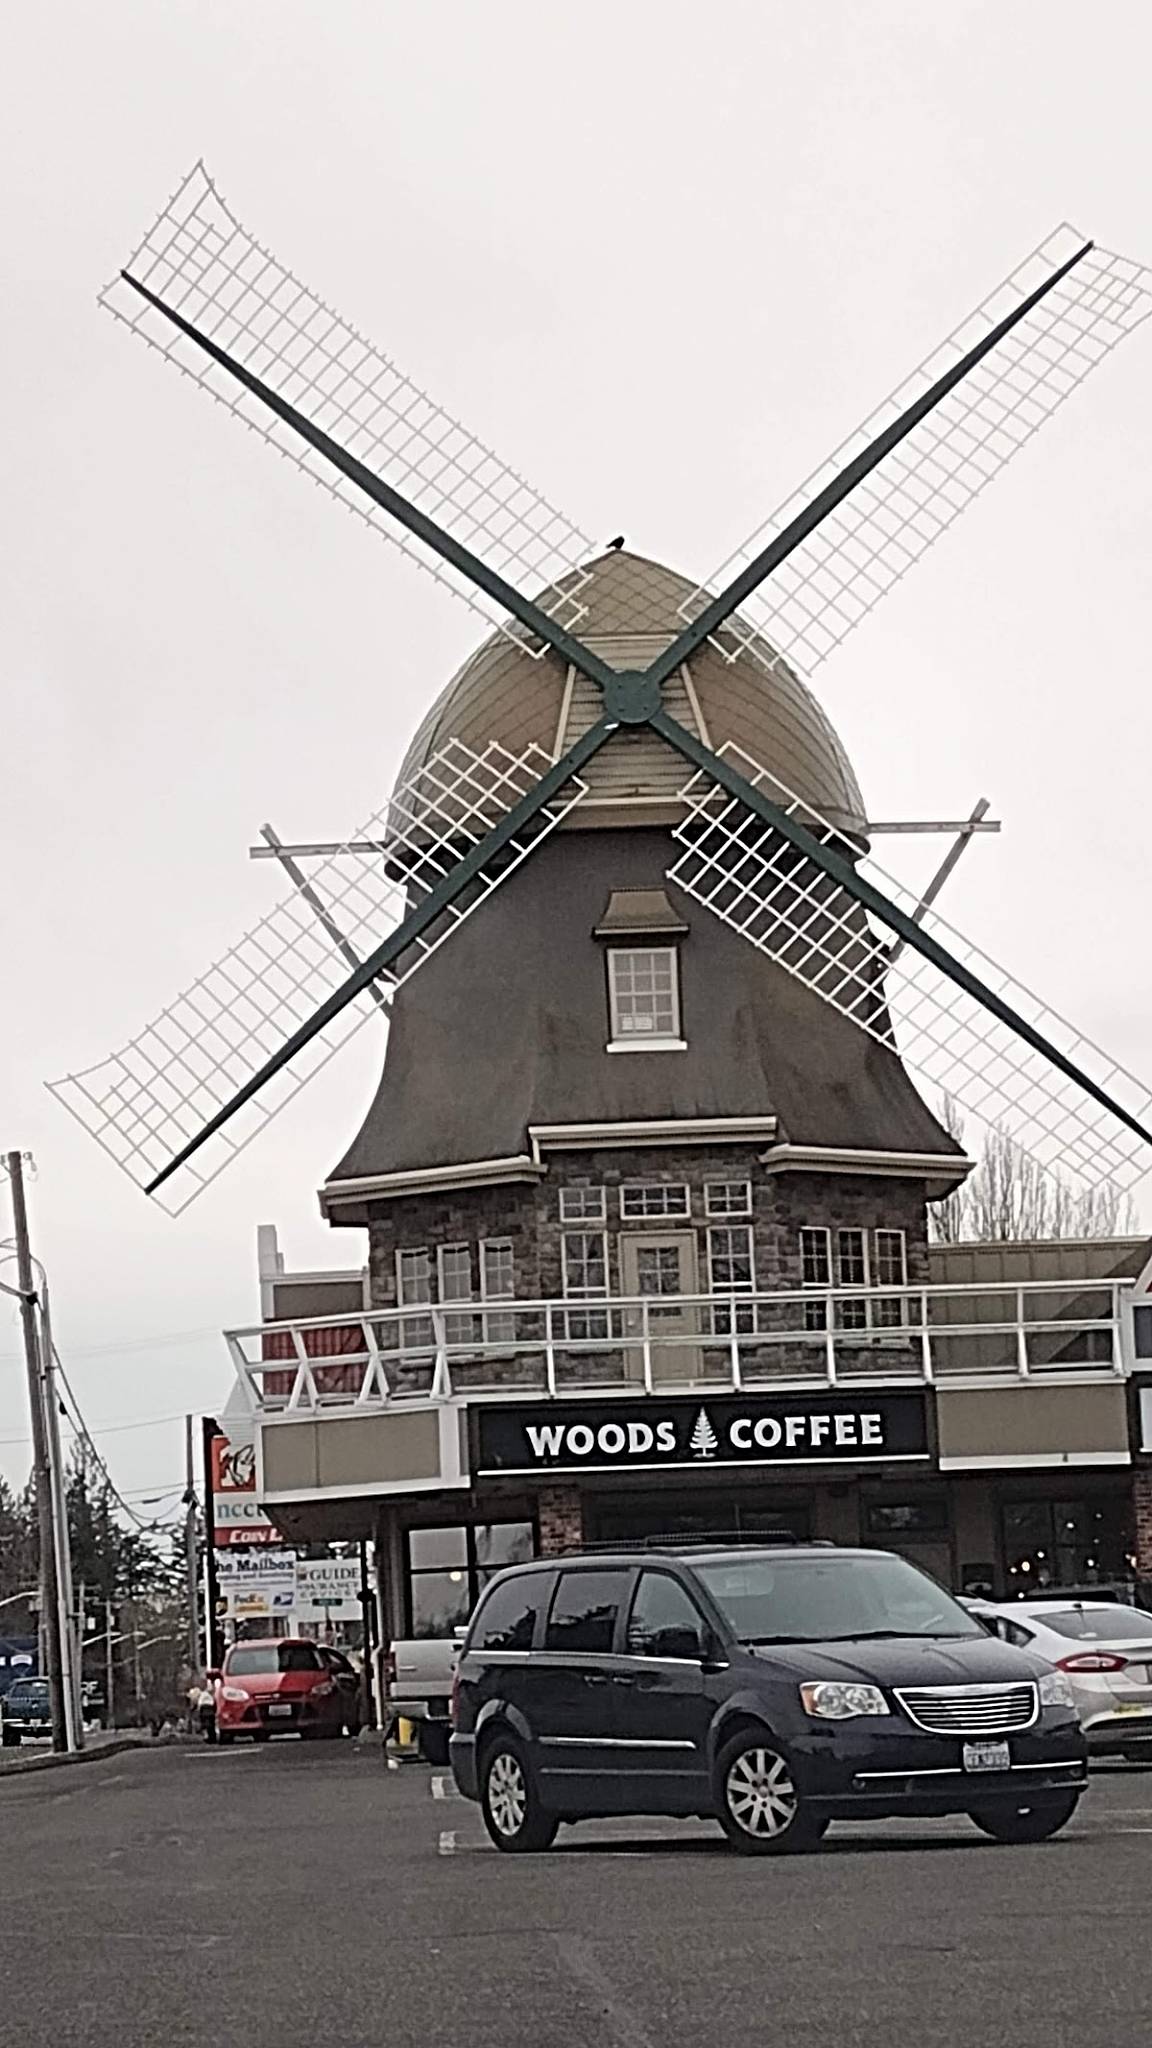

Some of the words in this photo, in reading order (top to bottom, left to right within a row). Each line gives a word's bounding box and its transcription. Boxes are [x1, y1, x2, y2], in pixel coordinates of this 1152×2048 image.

[525, 1422, 676, 1456] WOODS
[730, 1414, 883, 1448] COFFEE
[215, 1560, 233, 1572] he
[237, 1558, 294, 1571] Mailbox
[310, 1567, 359, 1580] GUIDE
